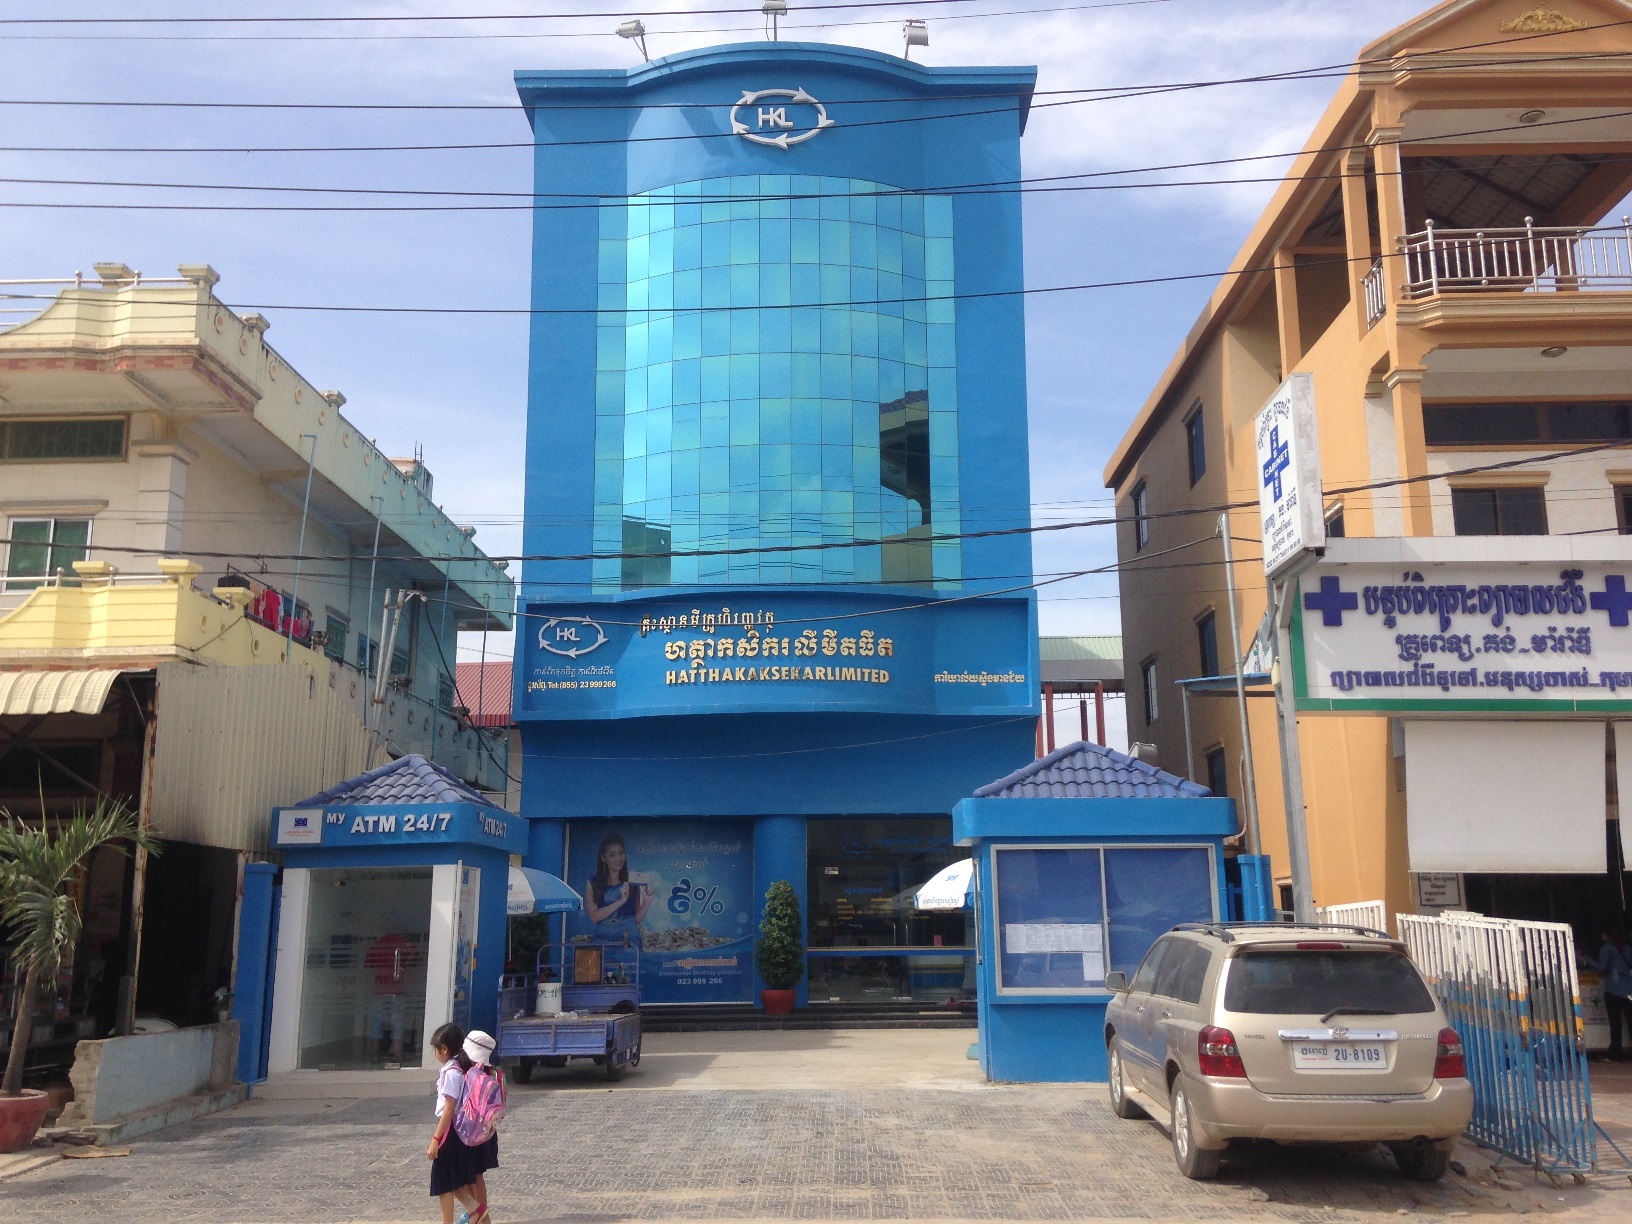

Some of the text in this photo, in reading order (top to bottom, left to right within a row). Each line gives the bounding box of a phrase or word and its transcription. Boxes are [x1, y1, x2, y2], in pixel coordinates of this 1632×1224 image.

[758, 107, 793, 128] HKL
[1264, 449, 1288, 478] CABINET
[556, 627, 580, 641] HKL
[350, 815, 396, 834] ATM
[402, 813, 452, 832] 24/7
[1334, 1048, 1380, 1061] 2U-8109
